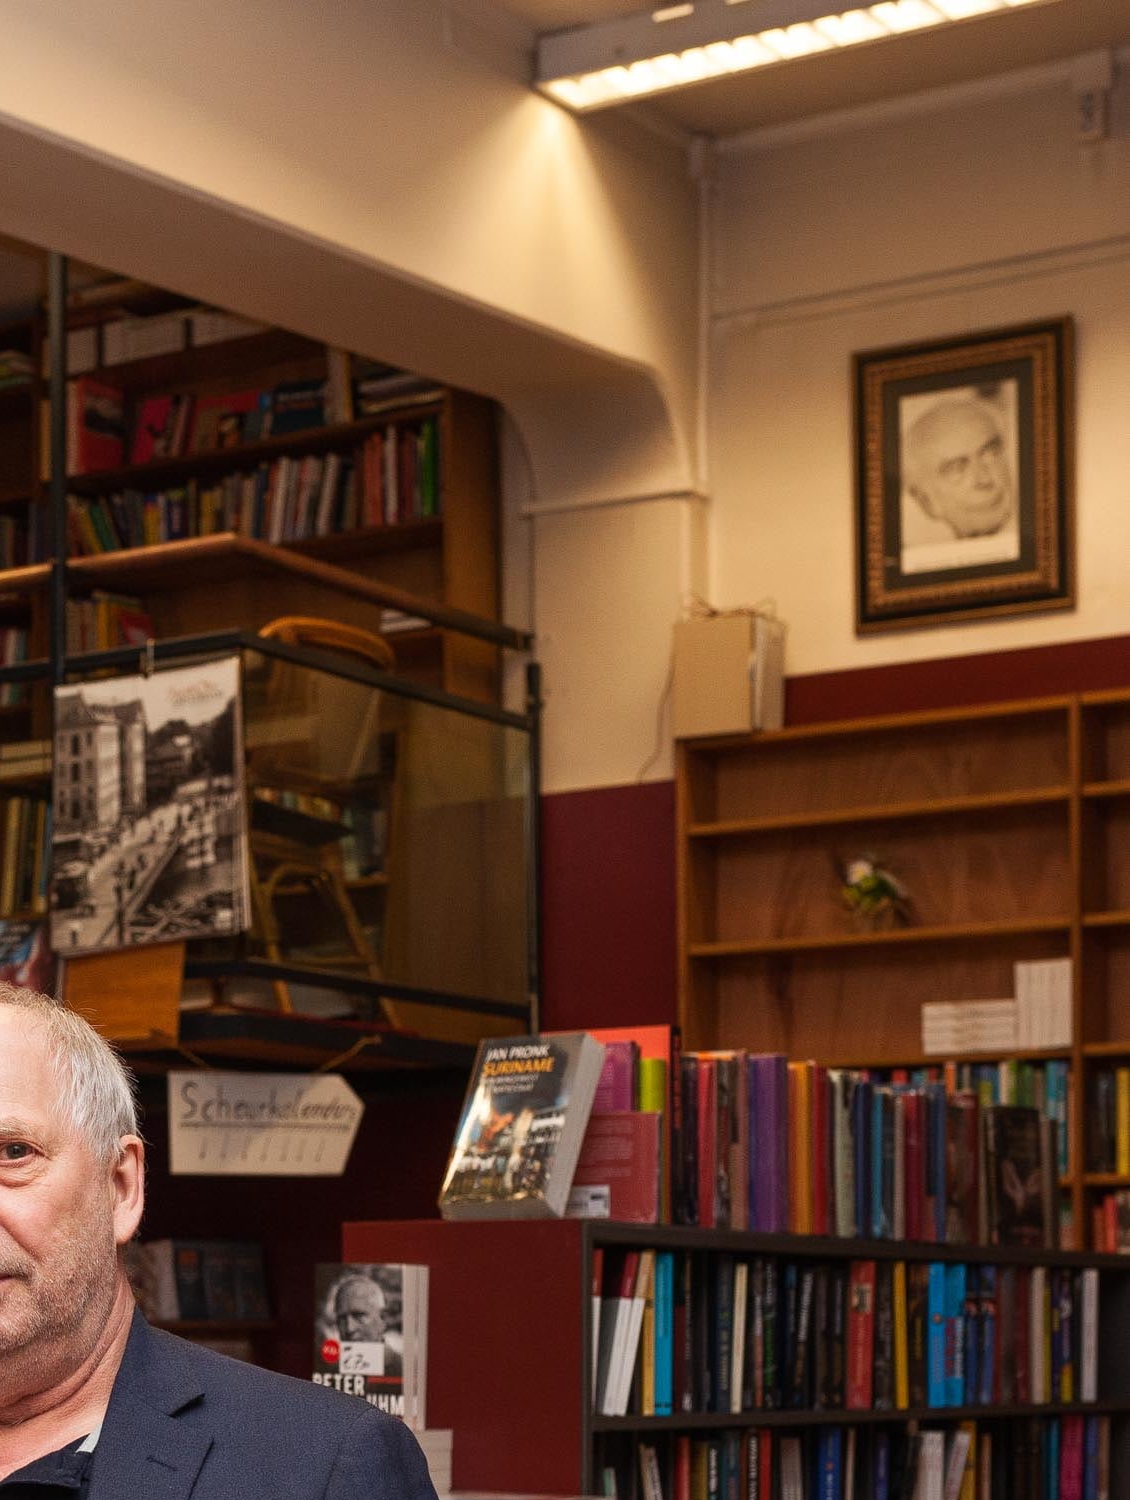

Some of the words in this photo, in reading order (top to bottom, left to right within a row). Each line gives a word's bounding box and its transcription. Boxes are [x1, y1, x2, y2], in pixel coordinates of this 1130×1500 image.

[486, 1047, 509, 1061] JAN
[508, 1044, 550, 1060] PRONK
[483, 1056, 555, 1077] SURINAME
